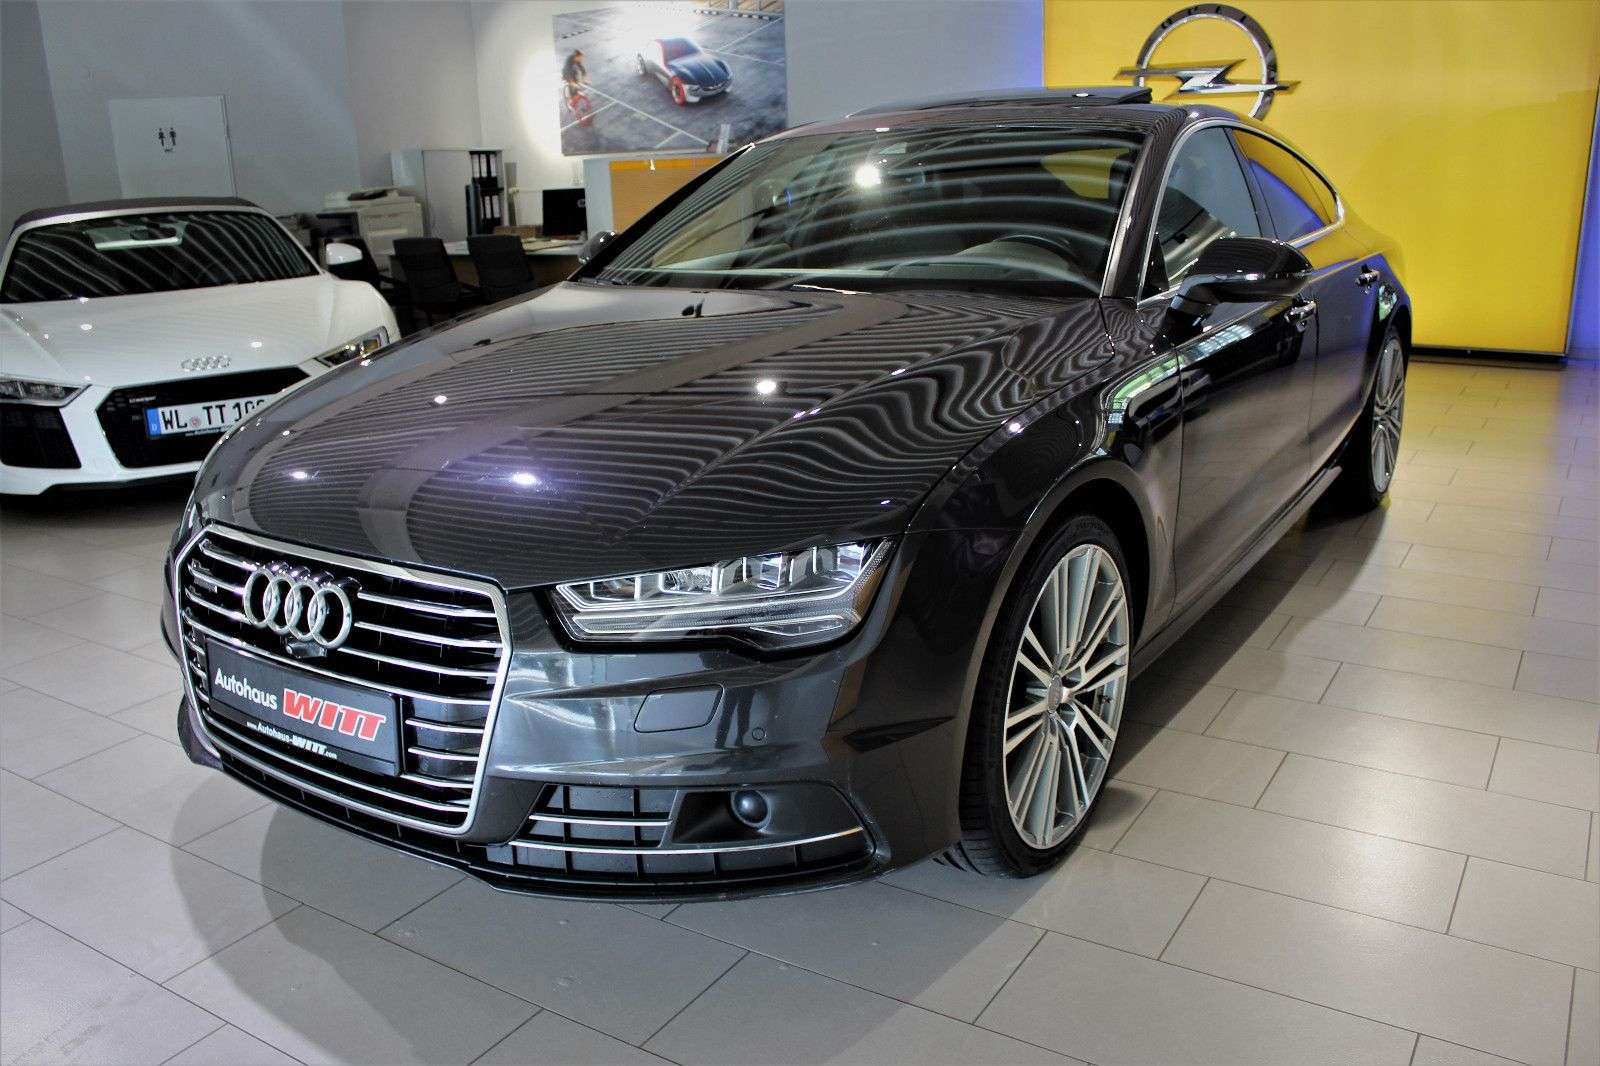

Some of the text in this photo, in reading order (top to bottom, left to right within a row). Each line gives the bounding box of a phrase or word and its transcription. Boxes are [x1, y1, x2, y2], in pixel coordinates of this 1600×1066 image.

[161, 409, 188, 430] WL
[203, 404, 226, 426] TT
[214, 667, 387, 742] Autohaus WITT
